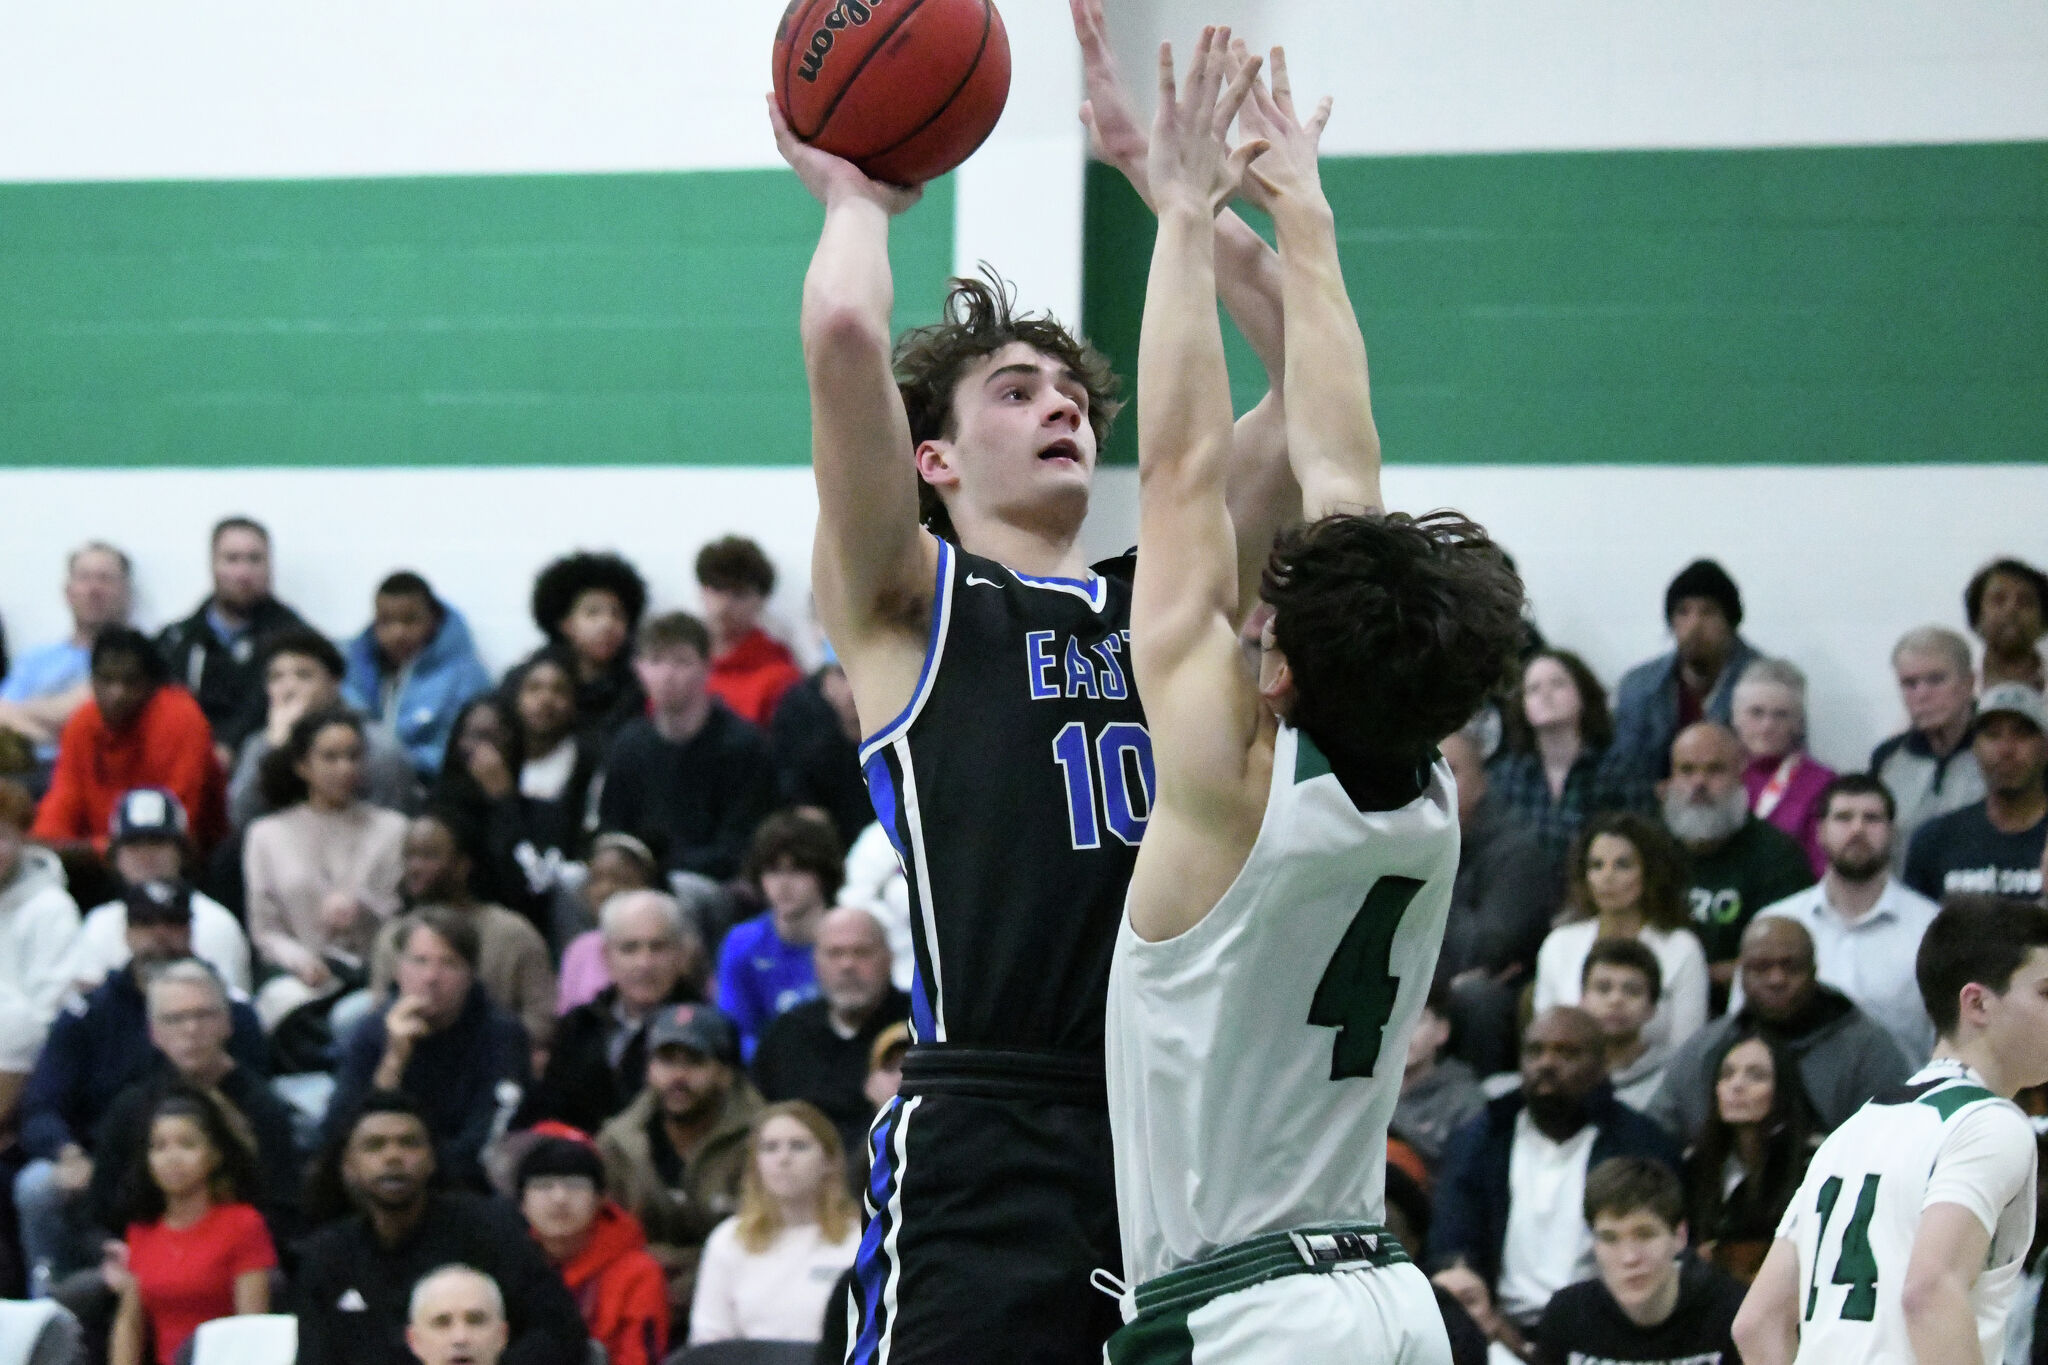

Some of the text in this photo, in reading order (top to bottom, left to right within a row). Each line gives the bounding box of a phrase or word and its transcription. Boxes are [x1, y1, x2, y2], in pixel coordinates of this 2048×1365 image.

[1052, 722, 1156, 850] 10
[1307, 875, 1427, 1081] 4
[1805, 1173, 1881, 1322] 14
